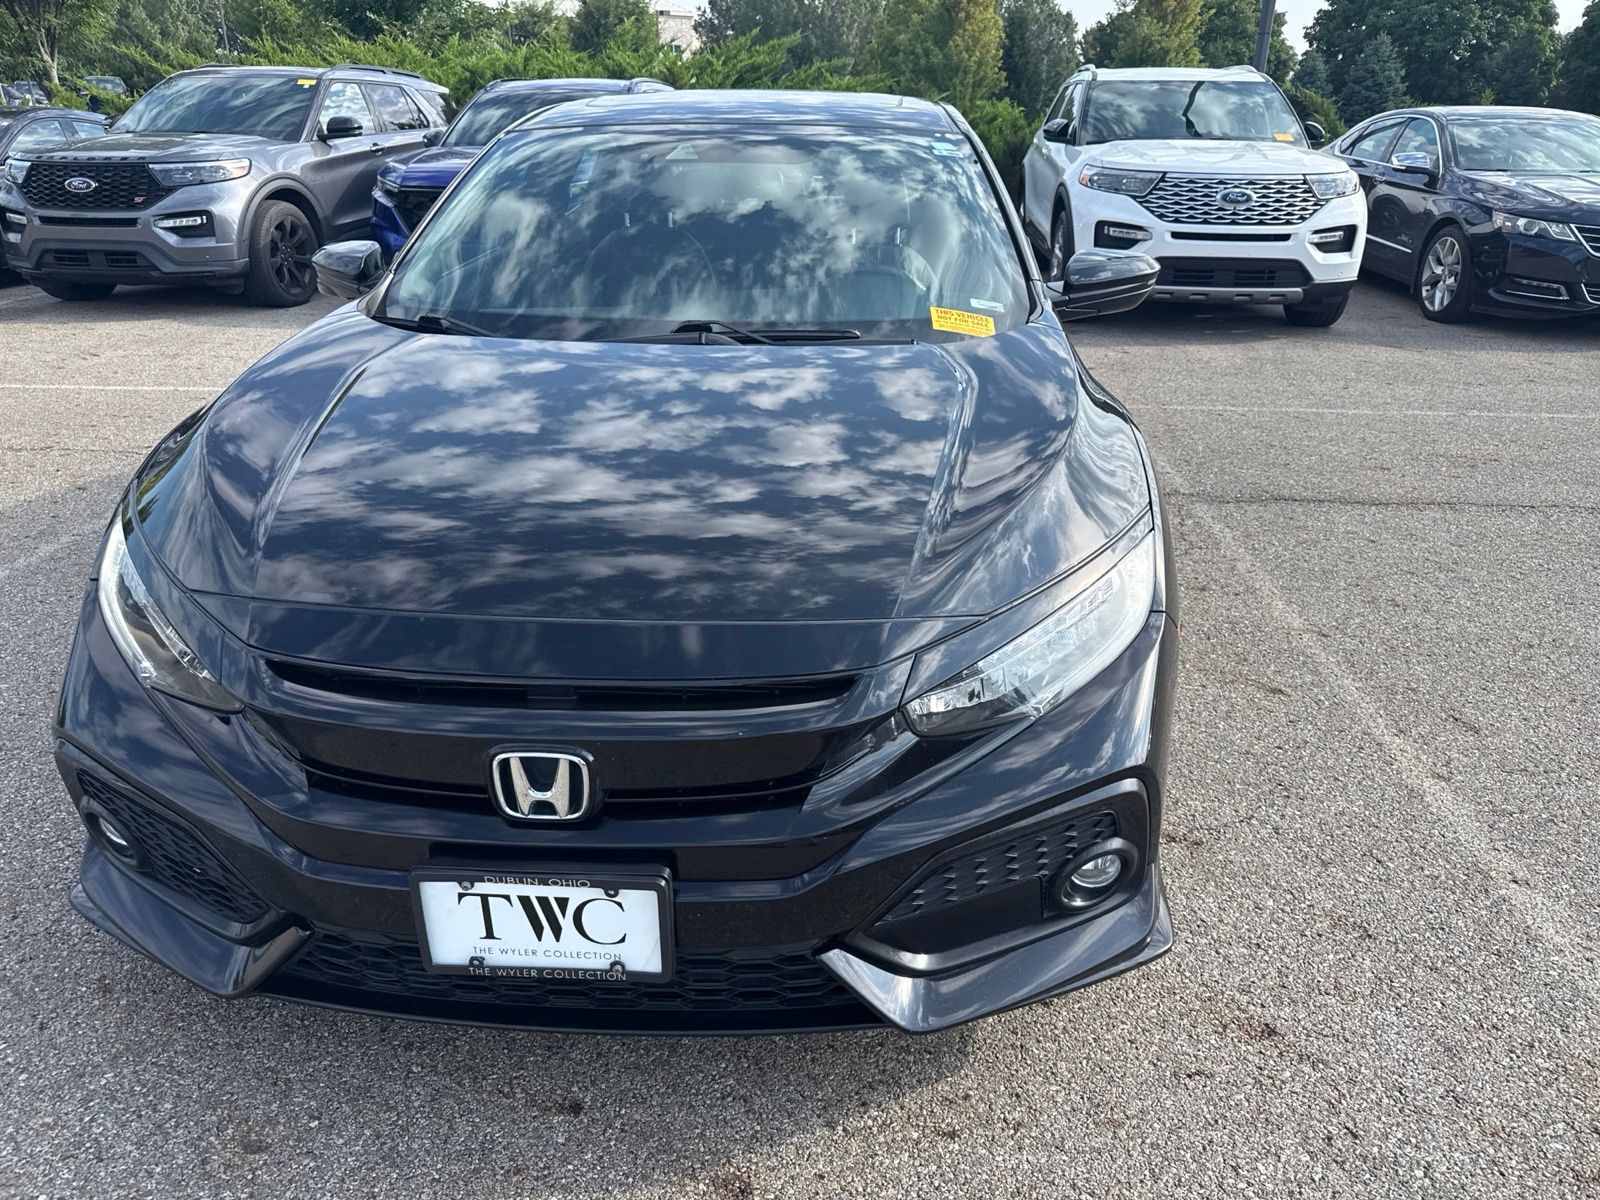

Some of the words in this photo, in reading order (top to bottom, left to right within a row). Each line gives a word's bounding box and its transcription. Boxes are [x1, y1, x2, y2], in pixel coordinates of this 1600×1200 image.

[935, 308, 955, 317] THIS
[956, 311, 991, 324] VEHICLE
[971, 320, 990, 328] SALE
[548, 878, 591, 888] OHIO
[457, 891, 627, 945] TWC
[473, 946, 494, 955] THE
[499, 947, 539, 957] WYLER
[543, 949, 622, 961] COLLECTION
[468, 966, 492, 977] THE
[496, 968, 539, 978] WYLER
[543, 969, 627, 981] COLLECTION
